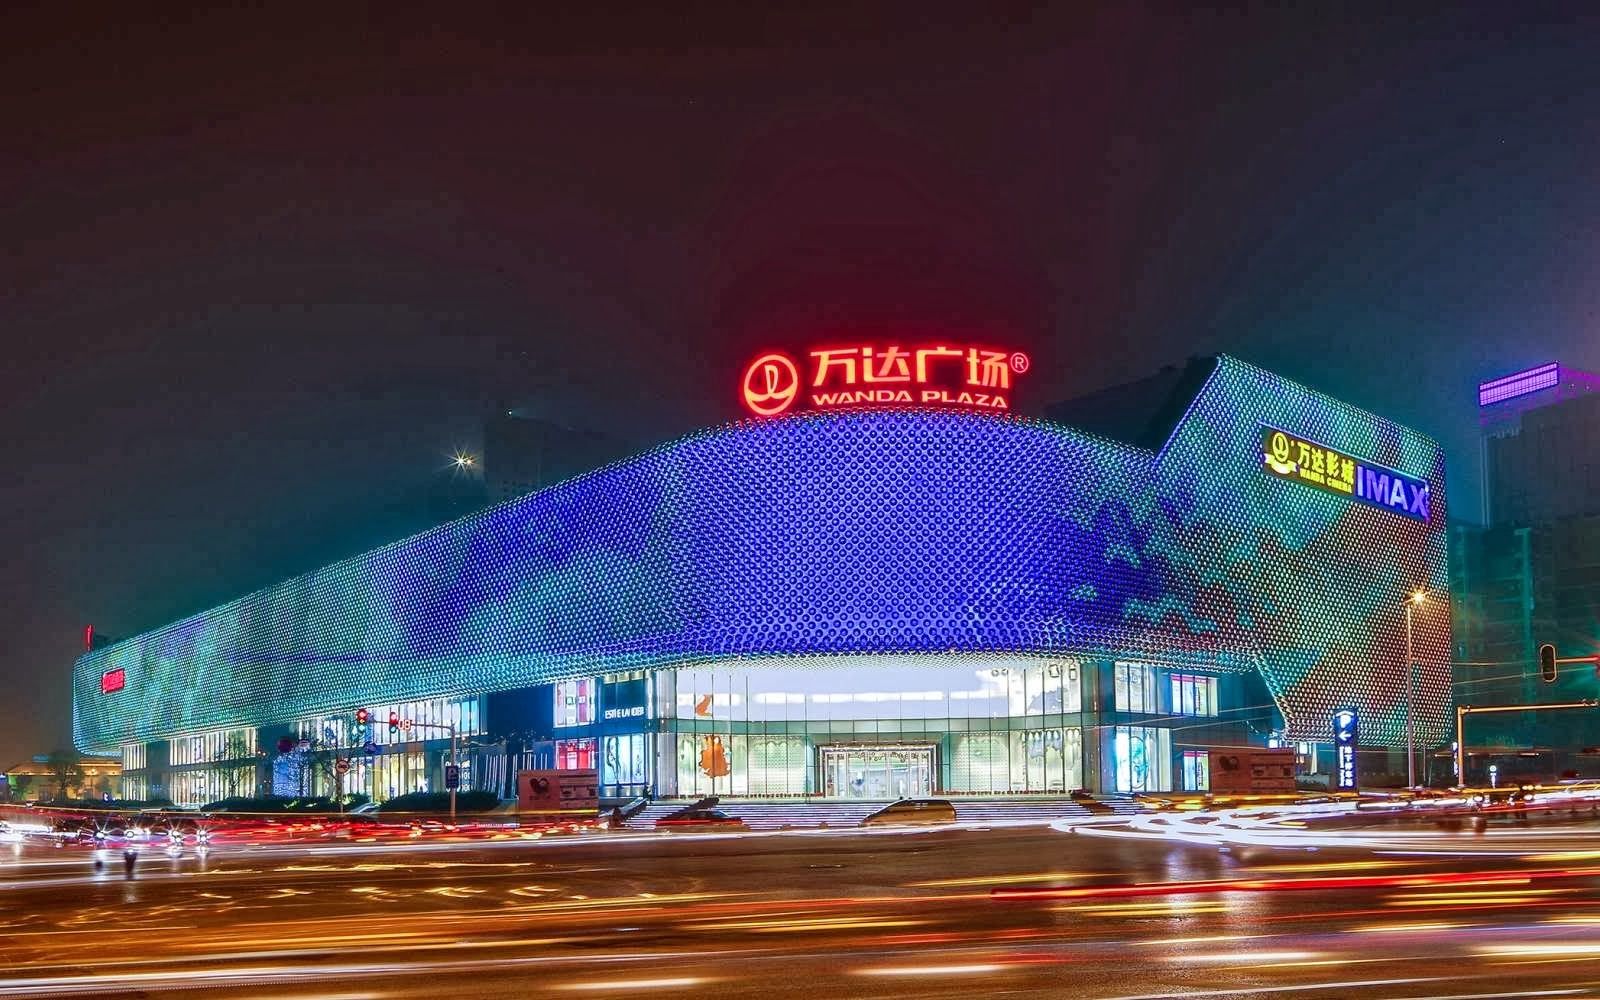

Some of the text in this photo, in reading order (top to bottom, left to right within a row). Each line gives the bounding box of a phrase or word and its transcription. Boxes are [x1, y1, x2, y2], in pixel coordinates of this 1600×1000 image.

[810, 346, 1009, 389] 万达广场
[812, 390, 1008, 408] WANDA PLAZA
[1297, 441, 1354, 485] 万达影城
[1356, 465, 1428, 517] IMAX
